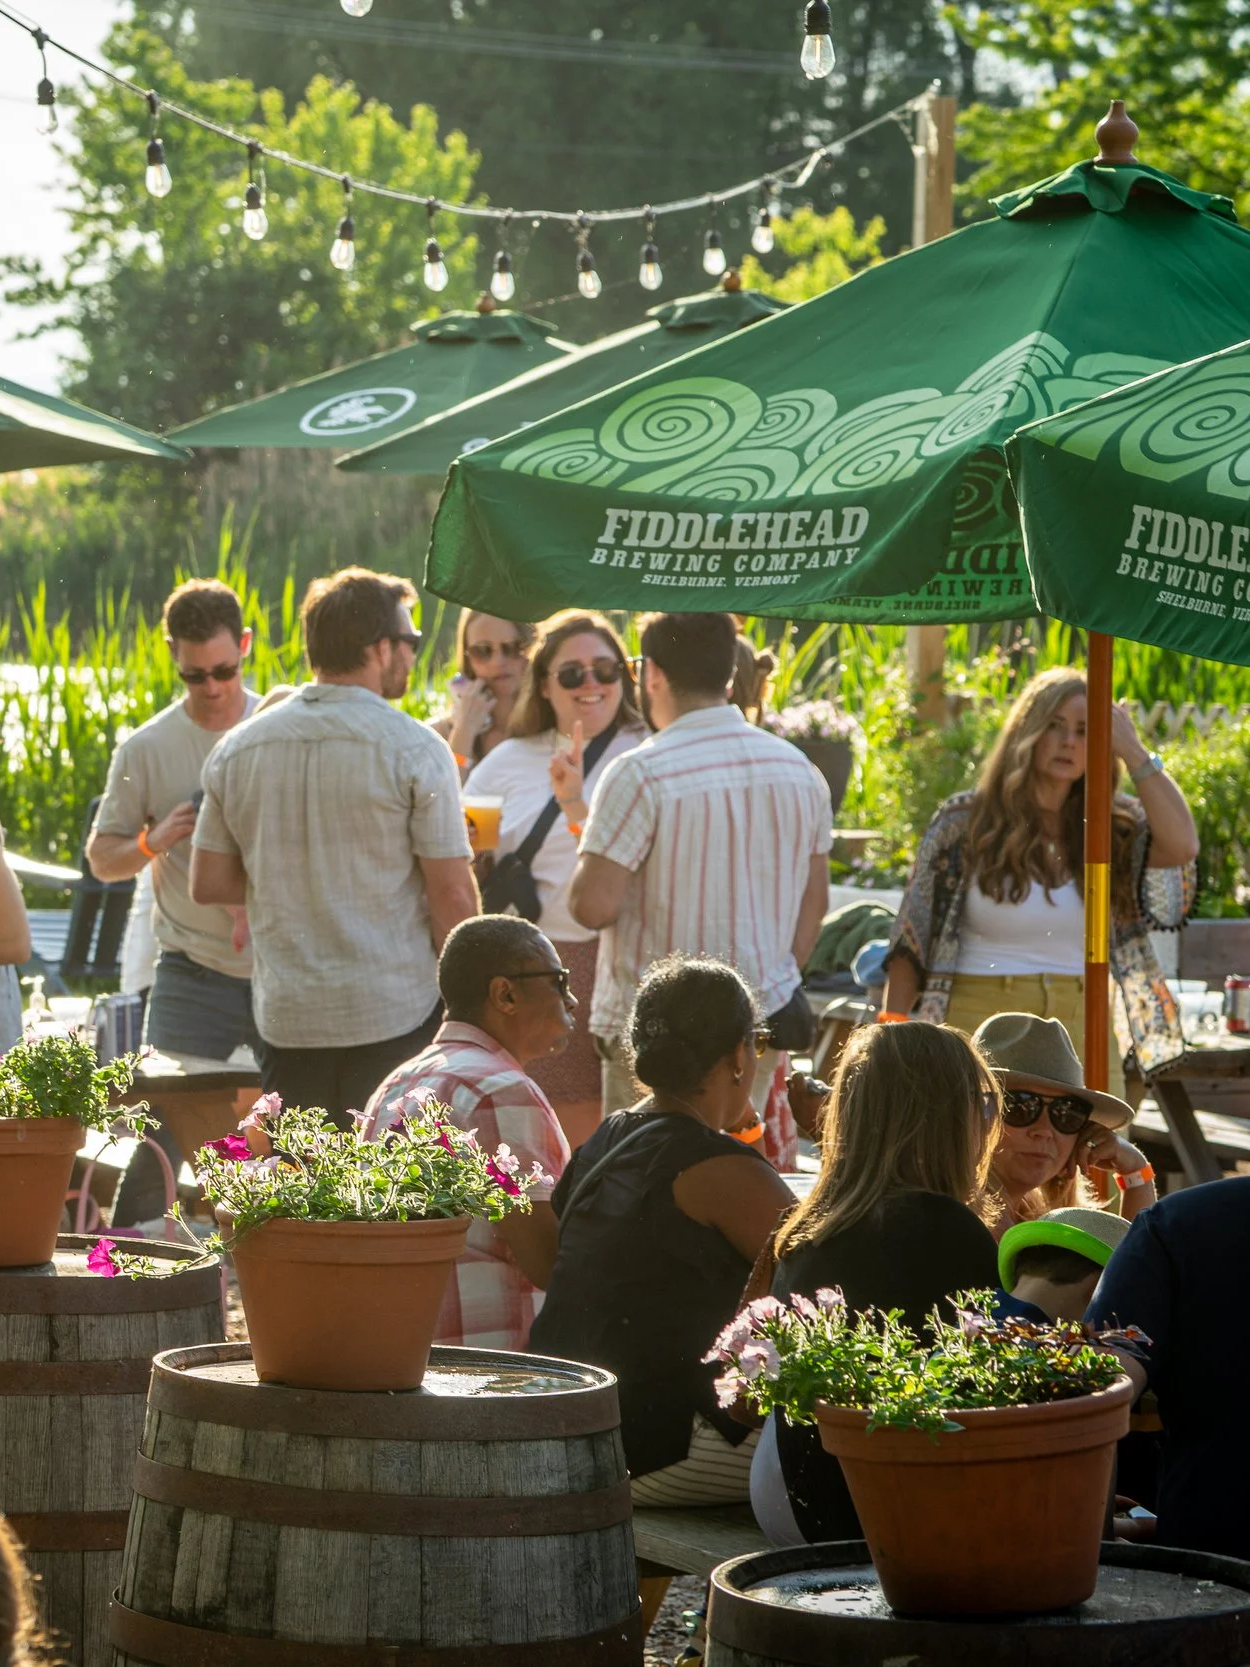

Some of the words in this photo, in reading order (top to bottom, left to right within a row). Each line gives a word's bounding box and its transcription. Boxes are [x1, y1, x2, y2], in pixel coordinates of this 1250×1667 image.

[597, 506, 869, 549] FIDDLEHEAD
[1124, 504, 1250, 573] FIDDLE
[589, 548, 722, 573] BREWING
[733, 547, 860, 573] COMPANY
[734, 573, 800, 587] VERMONT
[1116, 553, 1224, 597] BREWING
